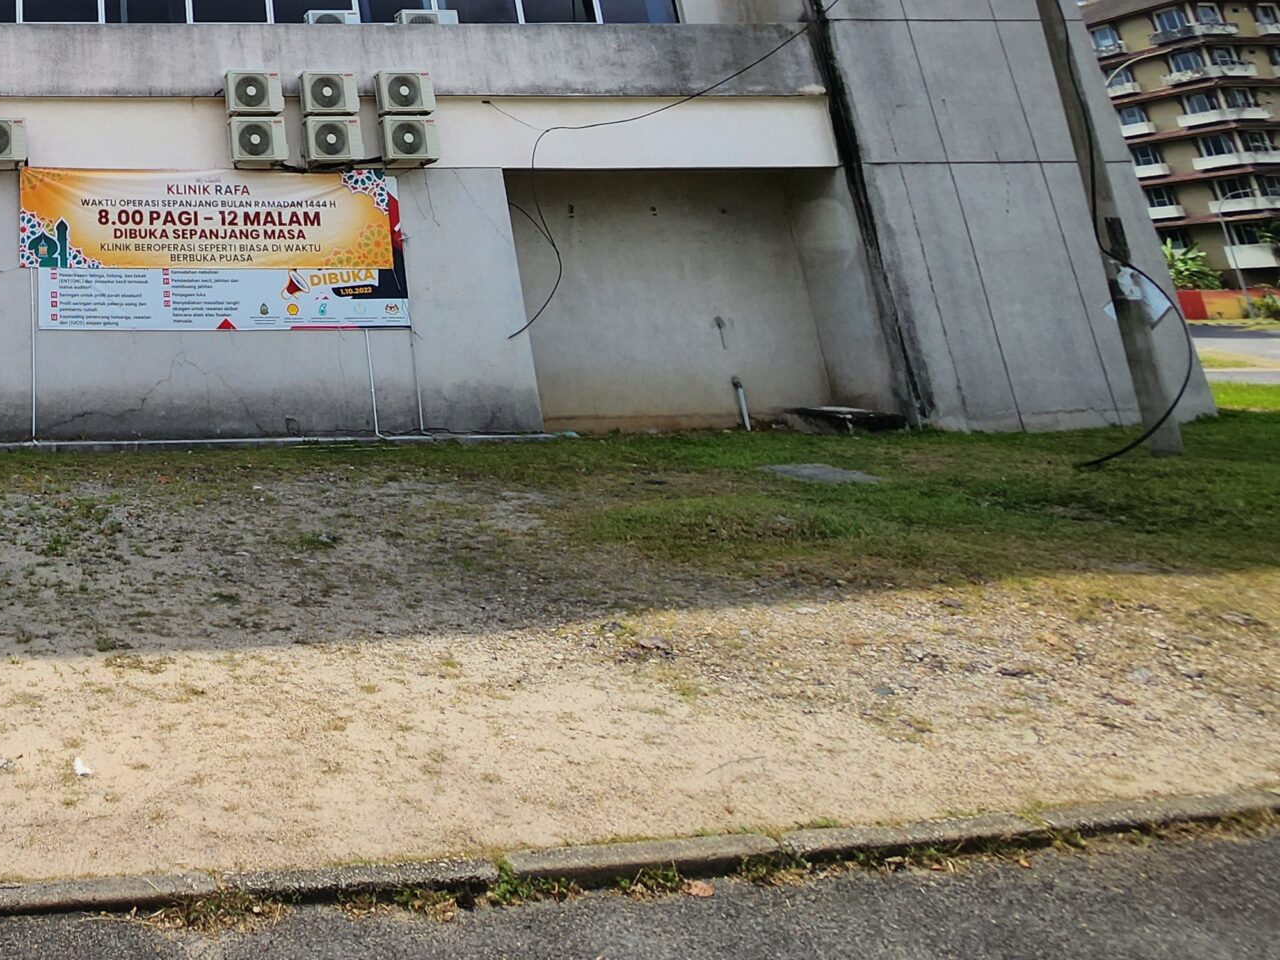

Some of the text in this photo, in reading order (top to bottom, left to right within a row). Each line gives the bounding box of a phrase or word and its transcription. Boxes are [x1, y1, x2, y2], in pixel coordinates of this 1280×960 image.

[166, 184, 251, 196] KLINIK RAFA
[81, 199, 116, 207] WAKTU
[119, 199, 159, 208] OPERASI
[161, 199, 219, 208] SEPANJANG
[221, 200, 252, 208] BULAN
[254, 200, 303, 208] RAMADAN
[305, 200, 327, 208] 1444
[97, 209, 144, 226] 8.00
[149, 210, 199, 226] PAGI
[219, 210, 239, 226] 12
[243, 211, 322, 227] MALAM
[113, 228, 307, 240] DIBUKA SEPANJANG MASA
[100, 243, 321, 252] KLINIK BEROPERASI SEPERTI BIASA DI WAKTU
[170, 254, 254, 262] BERBUKA PUASA
[309, 270, 377, 287] DIBUKA
[340, 286, 373, 296] 1.10.2022
